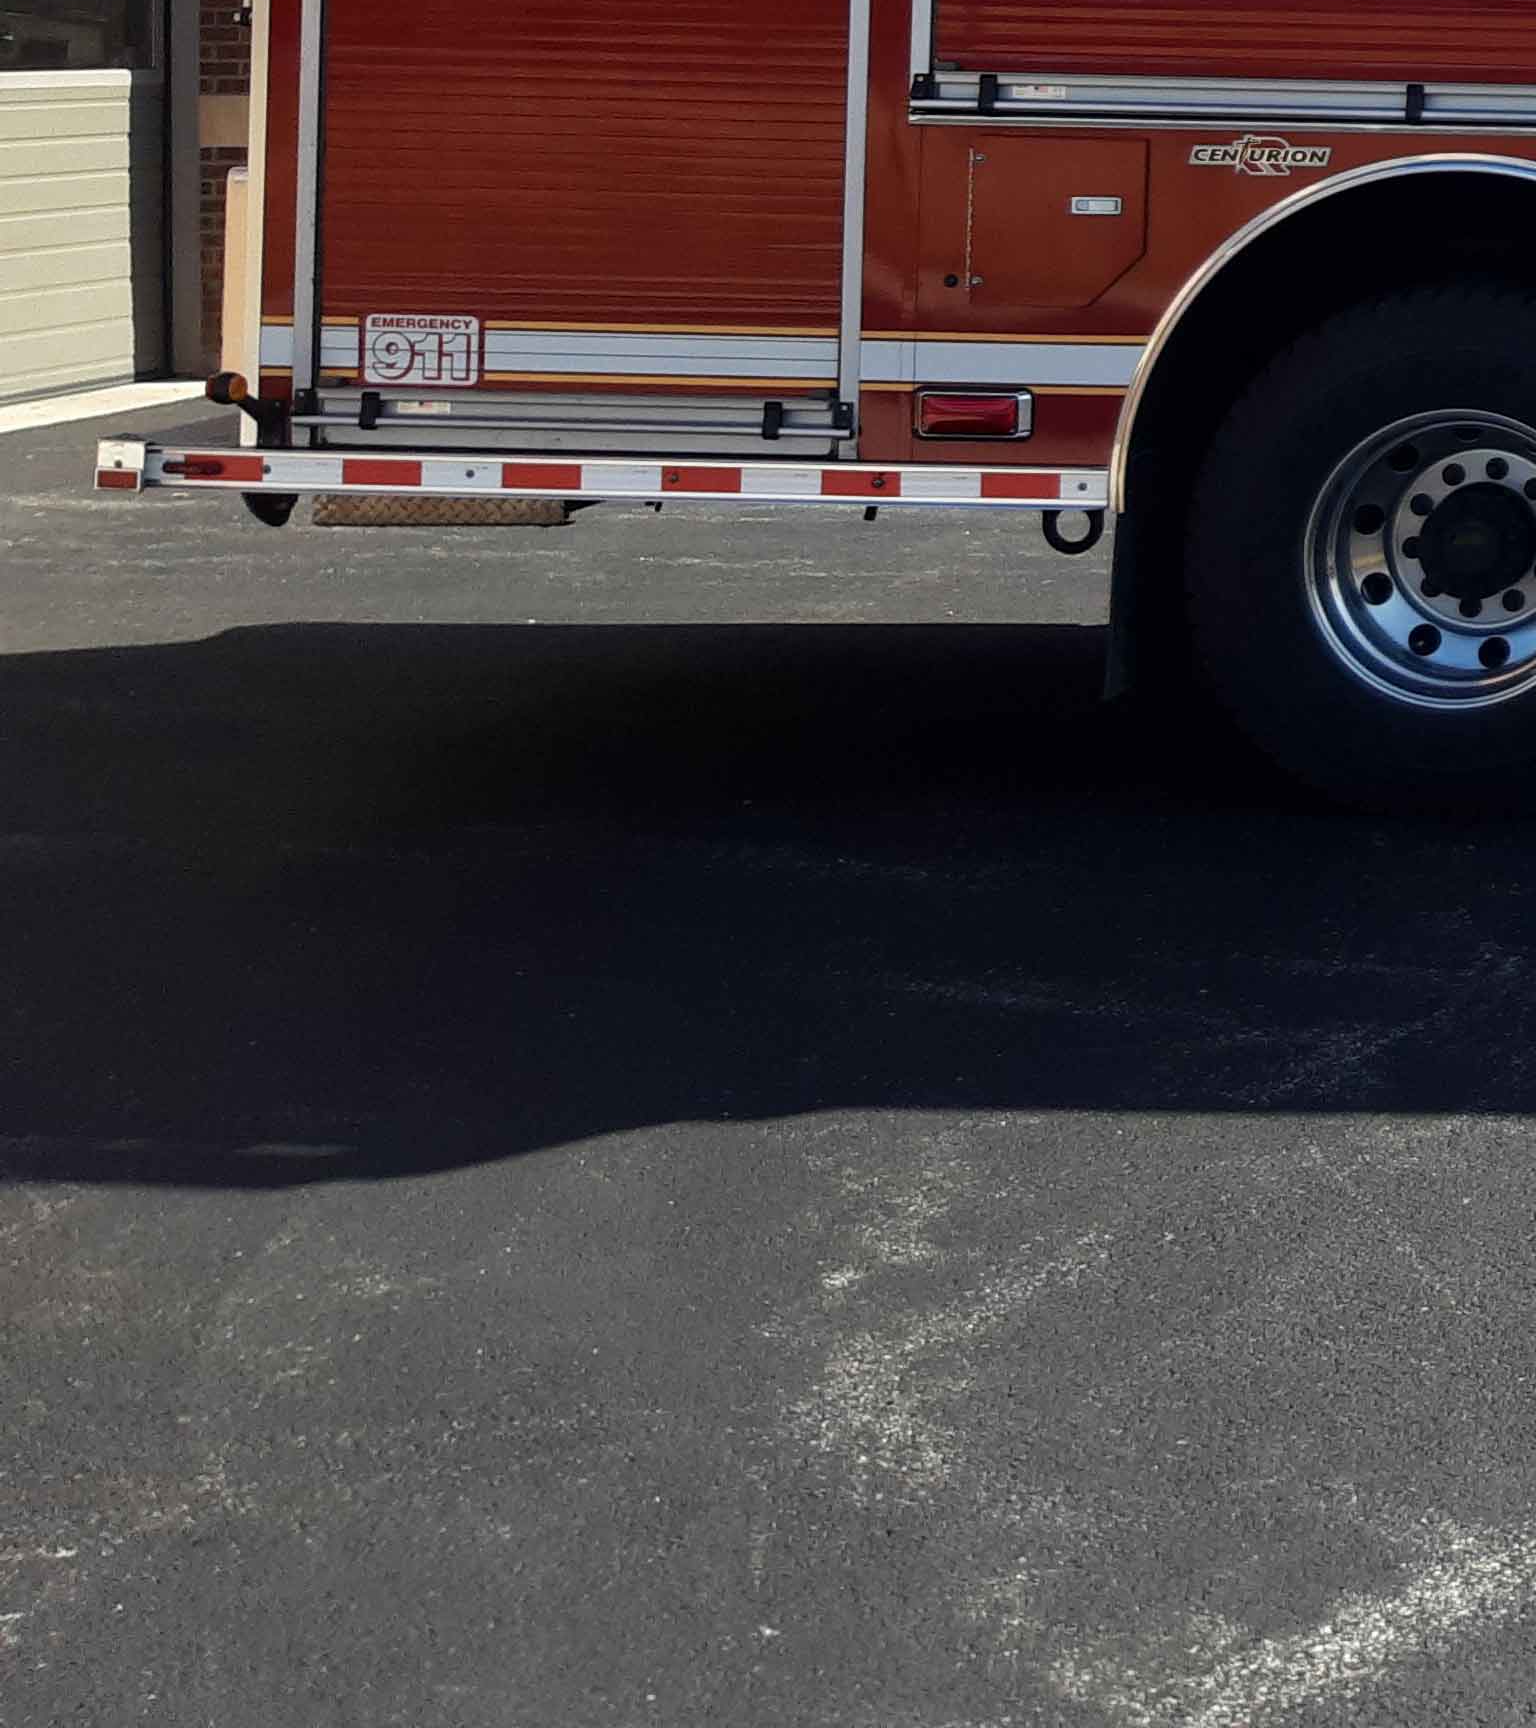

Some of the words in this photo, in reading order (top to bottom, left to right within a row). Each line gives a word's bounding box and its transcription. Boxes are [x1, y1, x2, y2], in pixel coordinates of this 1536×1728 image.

[1193, 141, 1327, 165] CENTURION
[371, 317, 472, 329] EMERGENCY
[372, 332, 471, 380] 911
